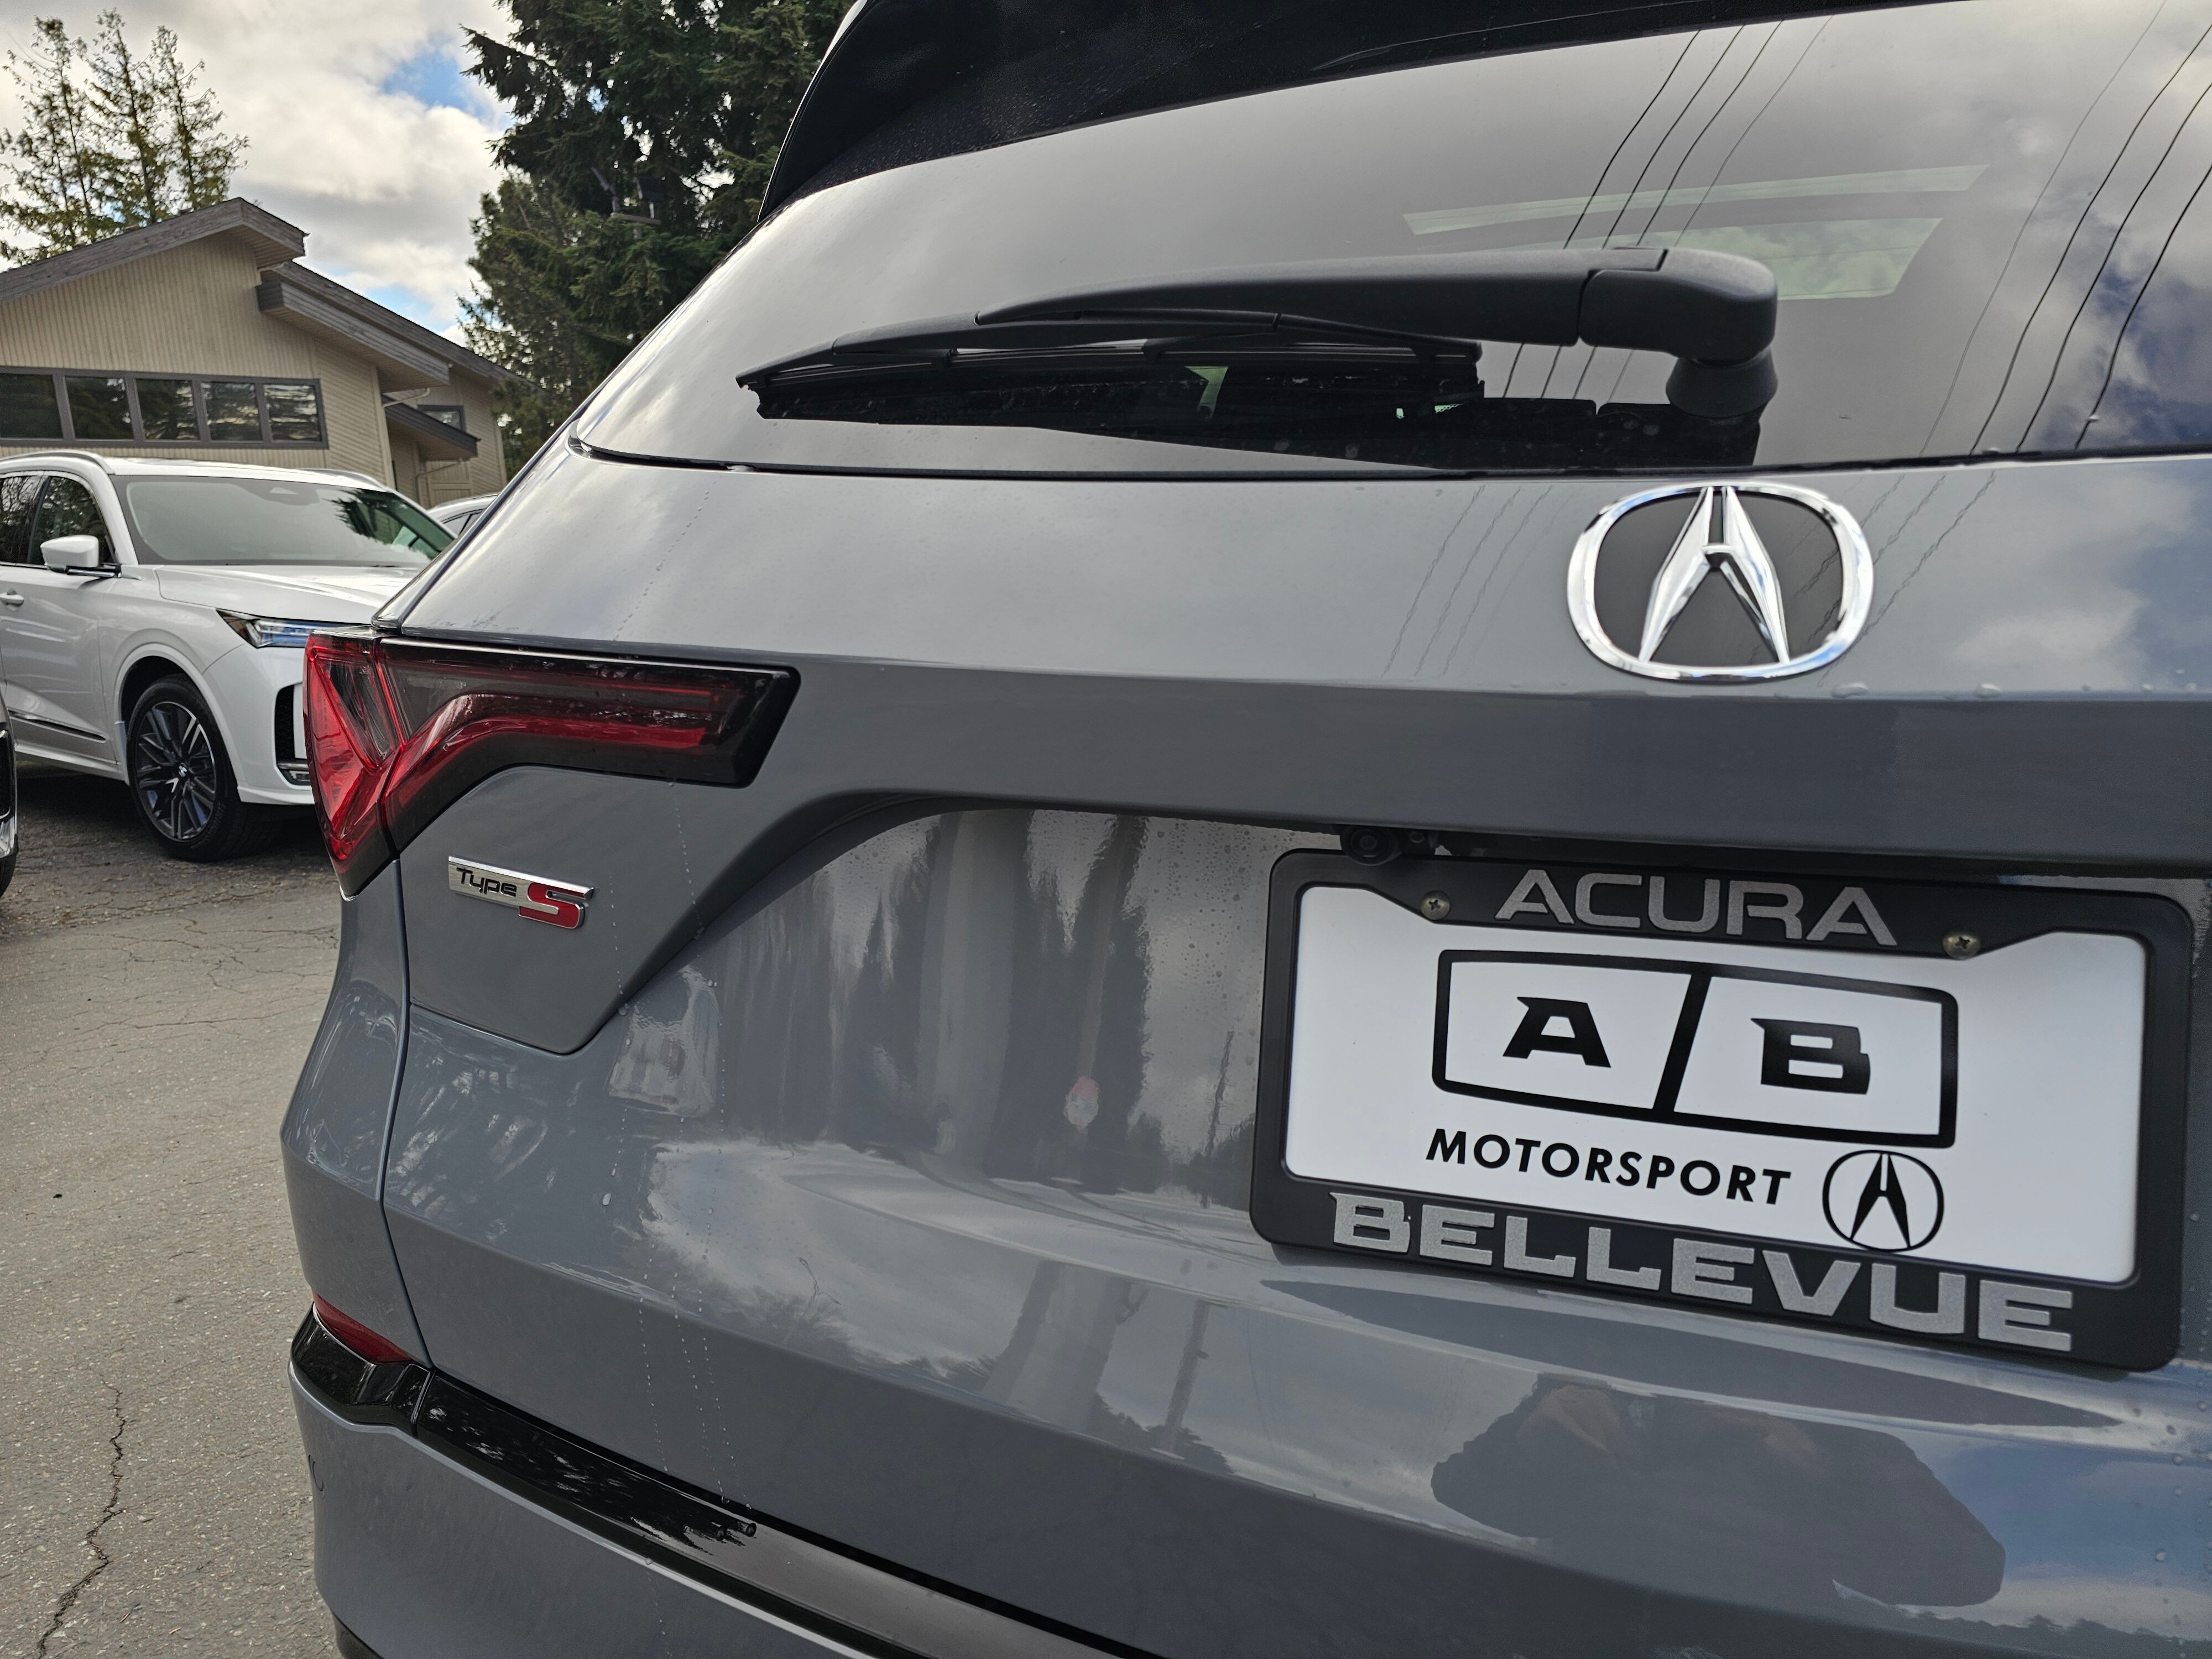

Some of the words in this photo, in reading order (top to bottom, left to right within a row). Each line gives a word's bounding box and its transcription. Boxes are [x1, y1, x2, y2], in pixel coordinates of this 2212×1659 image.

[456, 868, 517, 897] Type
[519, 881, 594, 929] S
[1495, 869, 1898, 946] ACURA
[1503, 997, 1611, 1068] A
[1751, 1018, 1871, 1094] B
[1426, 1128, 1792, 1205] MOTORSPORT
[1329, 1192, 2073, 1352] BELLEVUE
